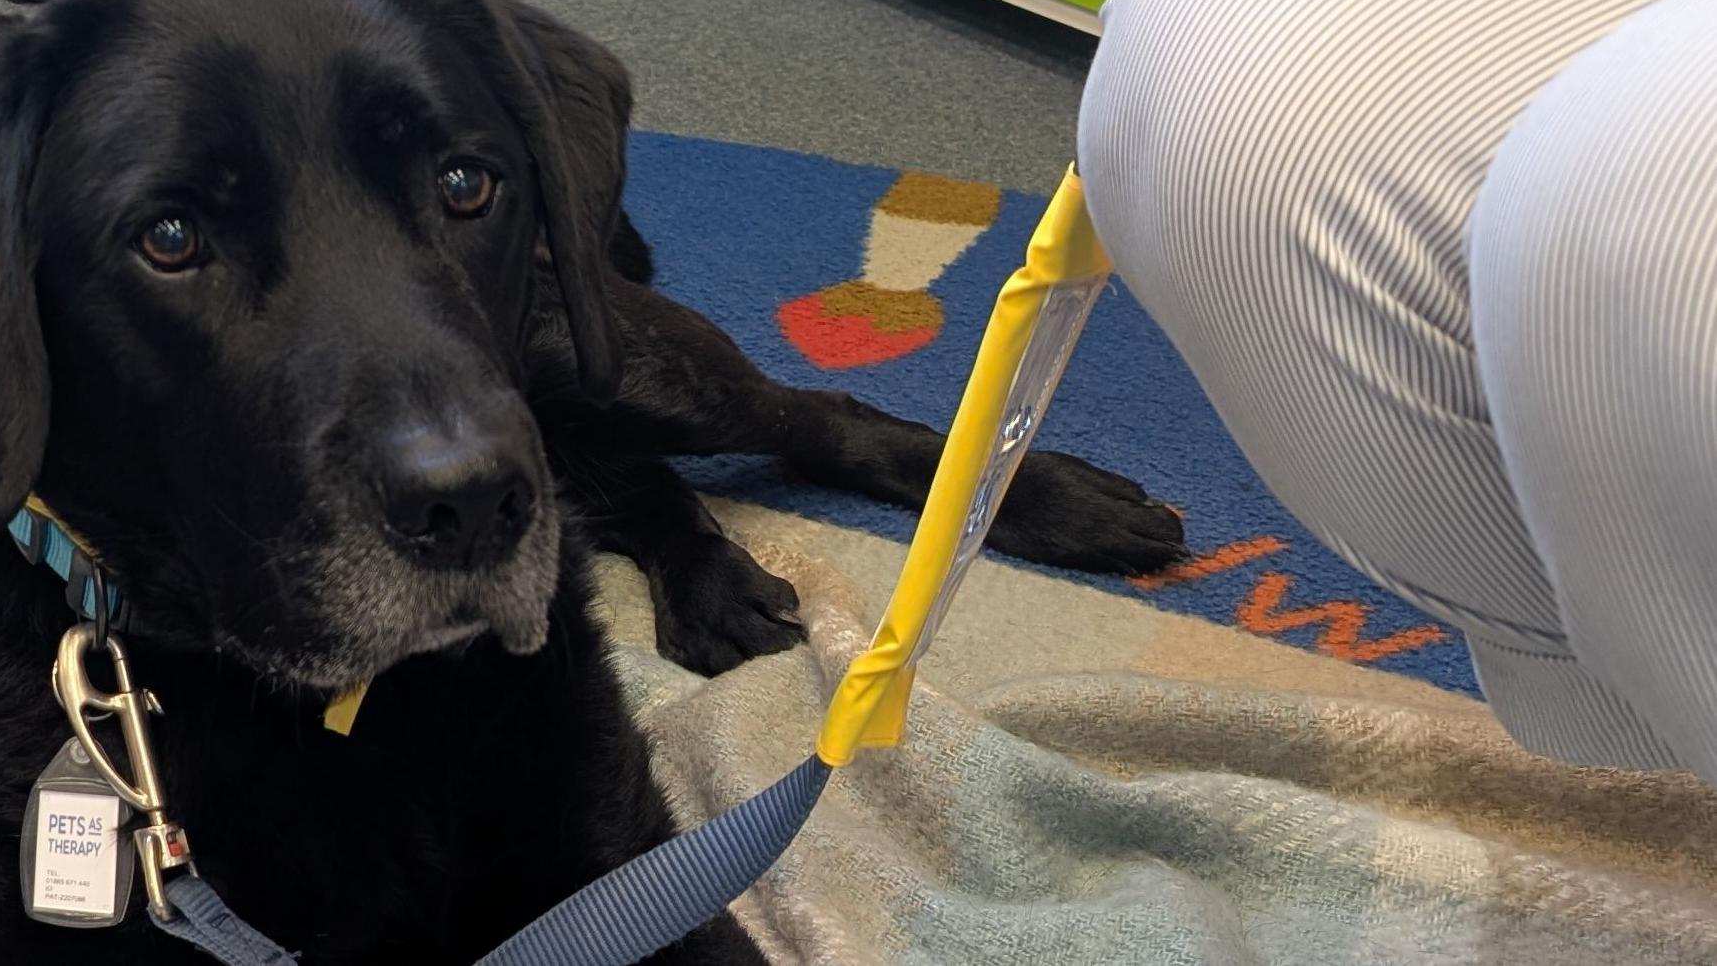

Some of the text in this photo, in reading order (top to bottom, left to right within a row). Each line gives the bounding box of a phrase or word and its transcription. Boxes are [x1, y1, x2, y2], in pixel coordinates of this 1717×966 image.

[49, 814, 103, 836] PETS AS
[48, 838, 101, 857] THERAPY
